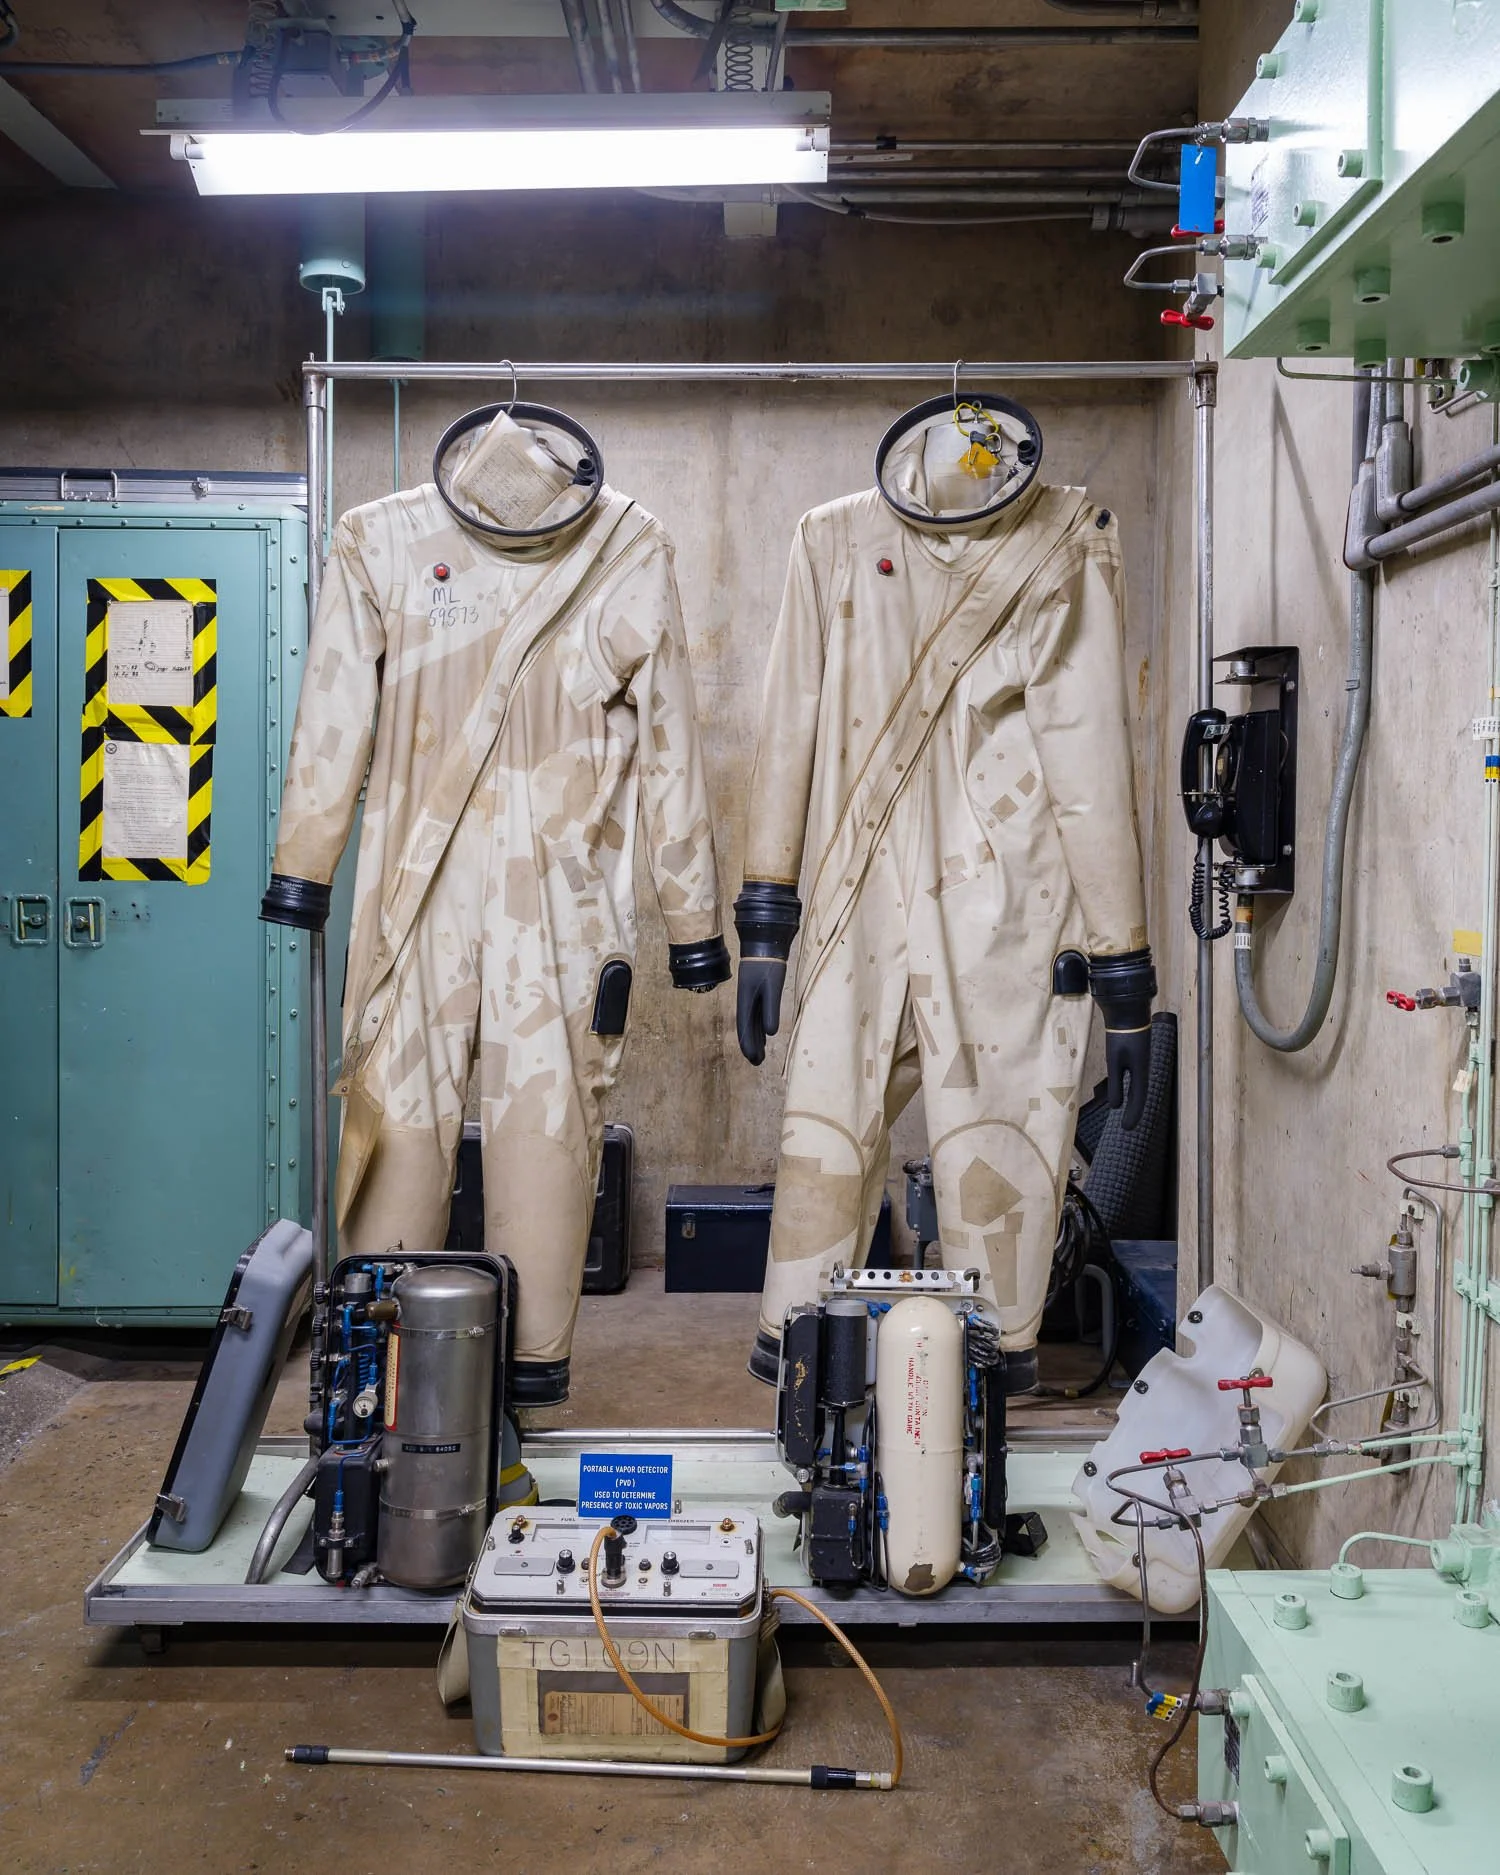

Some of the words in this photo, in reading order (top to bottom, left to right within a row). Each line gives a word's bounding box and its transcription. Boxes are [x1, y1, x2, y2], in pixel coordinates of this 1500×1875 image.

[433, 587, 461, 605] ML
[429, 606, 479, 627] 59573
[583, 1465, 613, 1473] PORTABLE
[637, 1466, 668, 1474] DETECTOR
[594, 1491, 610, 1499] USED
[612, 1491, 620, 1499] TO
[621, 1491, 656, 1500] DETERMINE
[581, 1501, 613, 1509] PRESENCE
[625, 1502, 642, 1510] TOXIC
[644, 1502, 668, 1510] VAPORS
